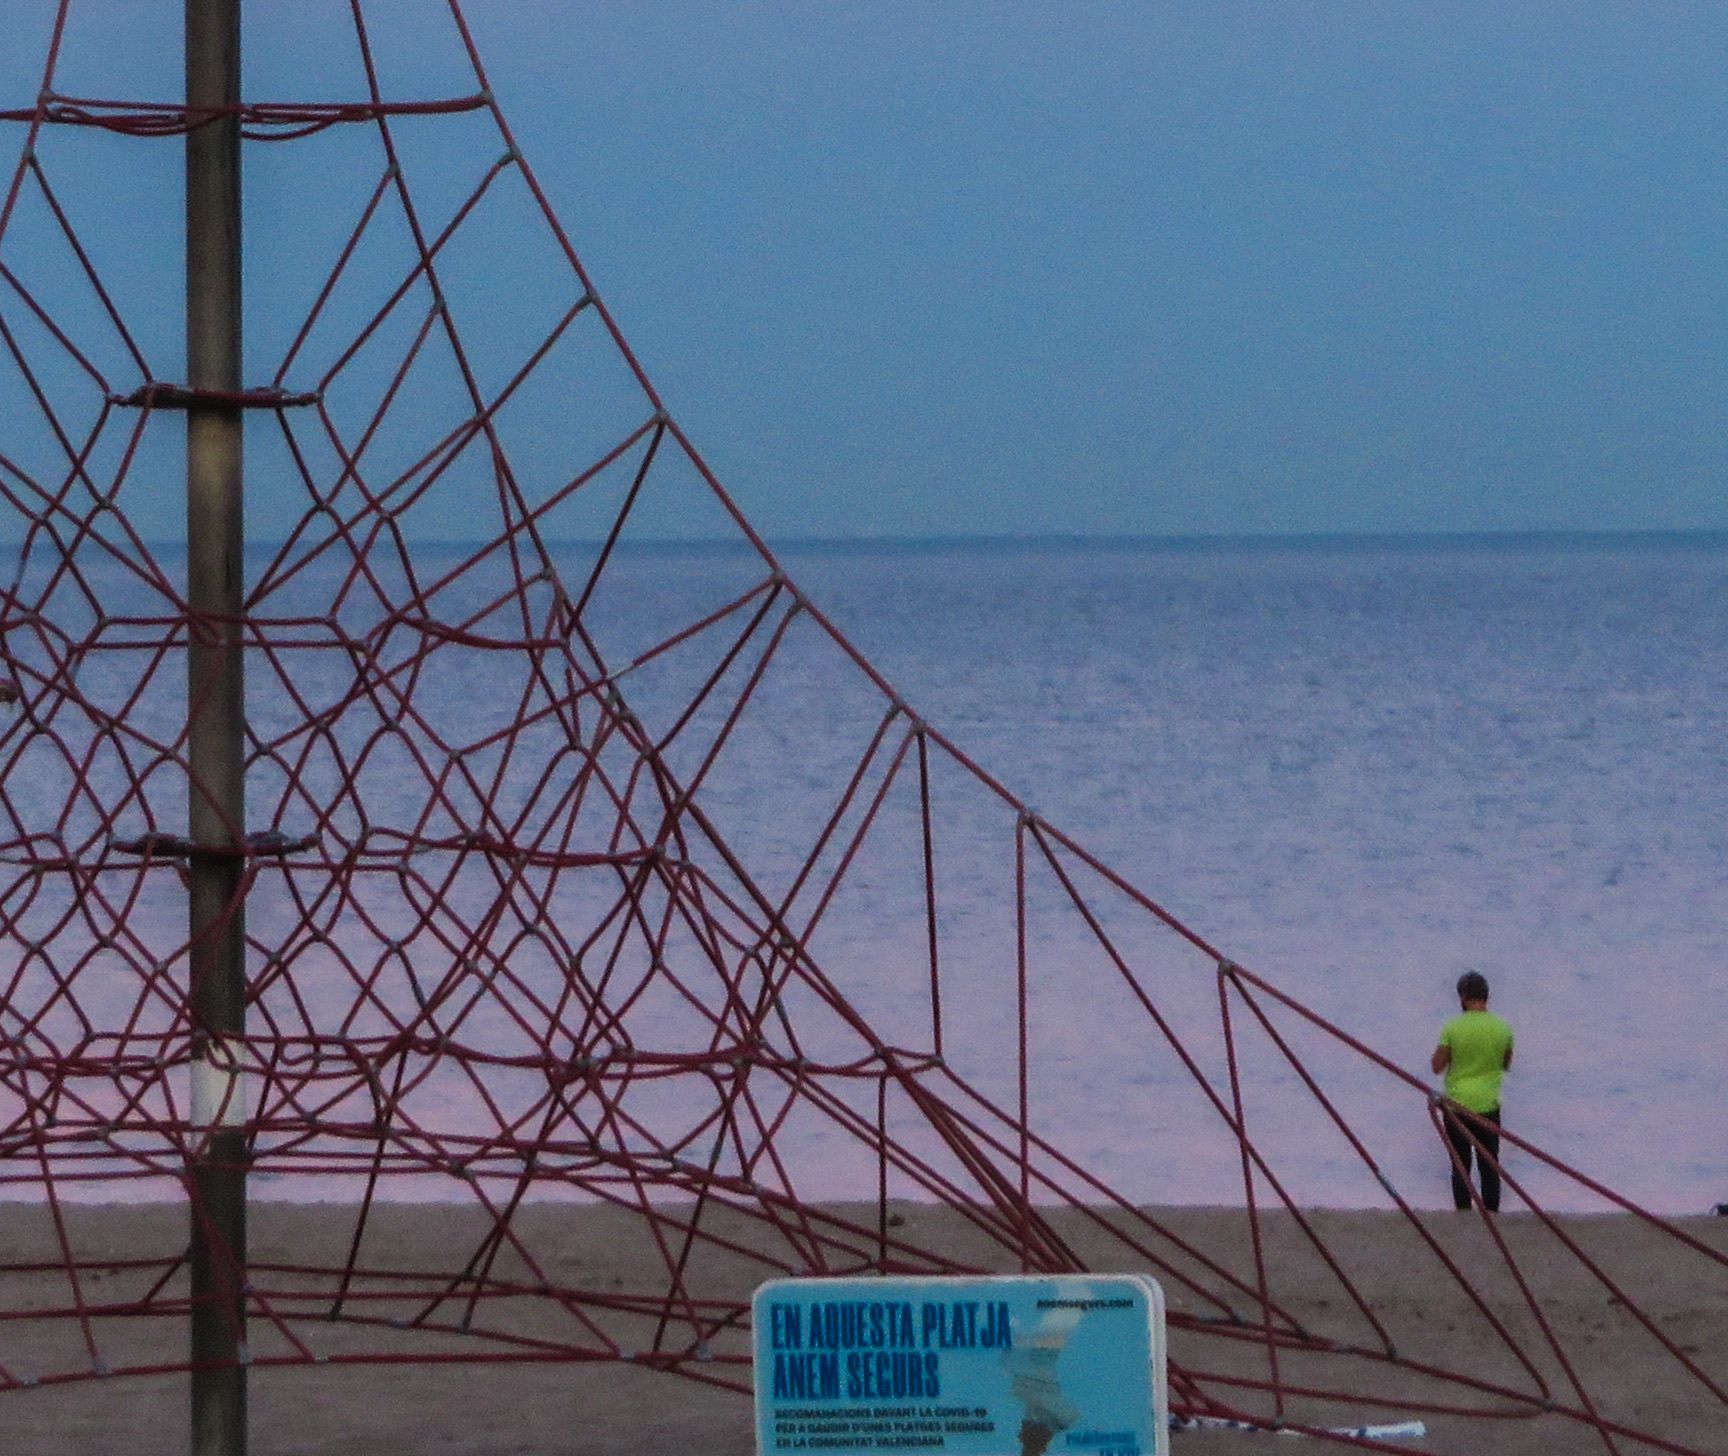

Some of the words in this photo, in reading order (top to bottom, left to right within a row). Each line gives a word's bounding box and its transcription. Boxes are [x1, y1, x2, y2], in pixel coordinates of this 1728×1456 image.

[771, 1302, 800, 1348] EN
[810, 1302, 915, 1350] AQUESTA
[922, 1301, 1011, 1349] PLATJA
[774, 1352, 839, 1399] ANEM
[846, 1352, 940, 1398] SEGURS
